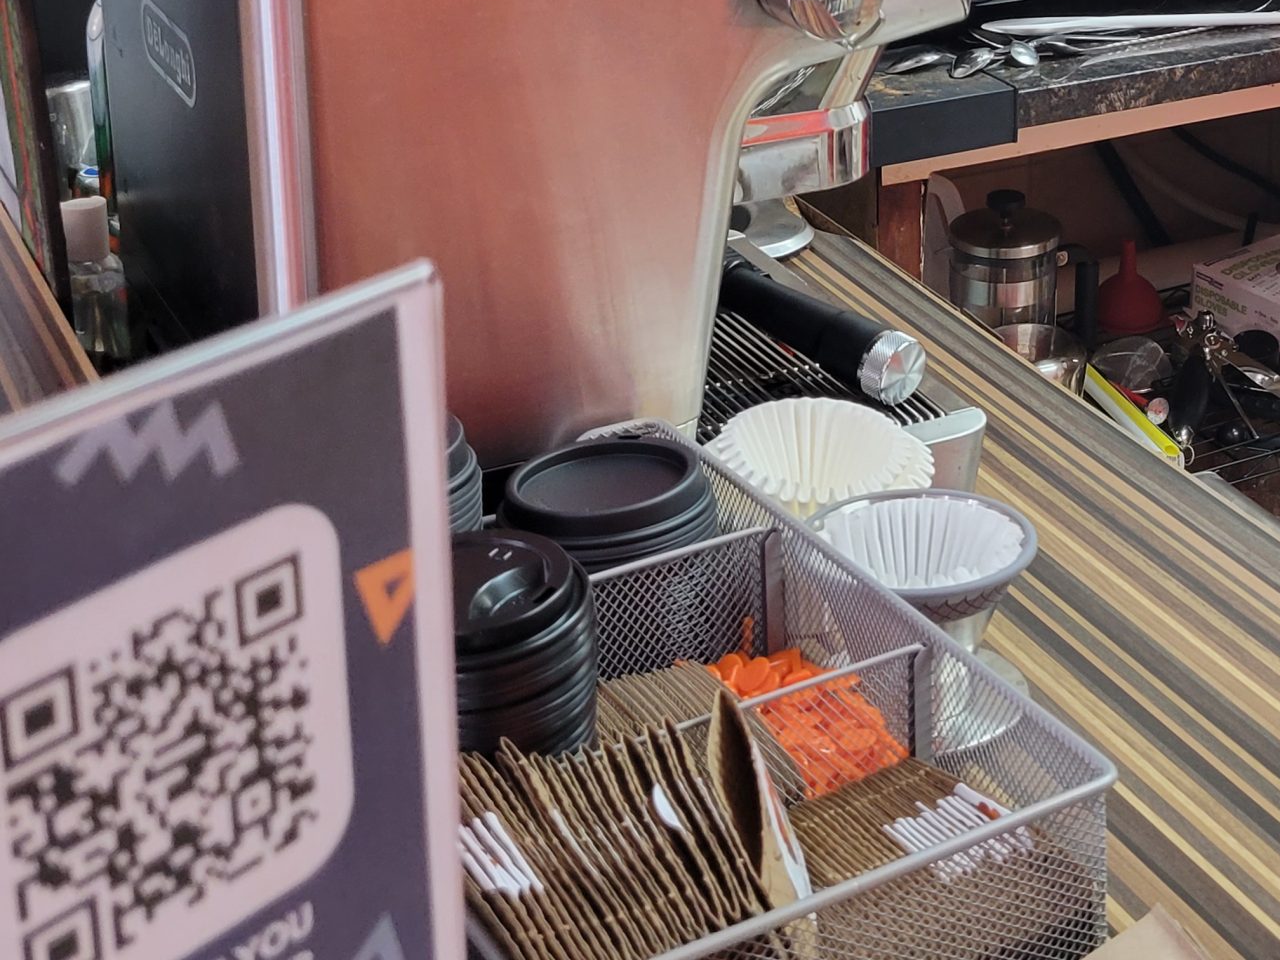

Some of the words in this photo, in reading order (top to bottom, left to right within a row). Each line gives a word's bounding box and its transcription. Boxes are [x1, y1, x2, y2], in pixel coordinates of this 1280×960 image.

[1195, 285, 1248, 316] DISPOSABLE
[1195, 296, 1228, 317] GLOVES
[231, 900, 315, 960] YOU
